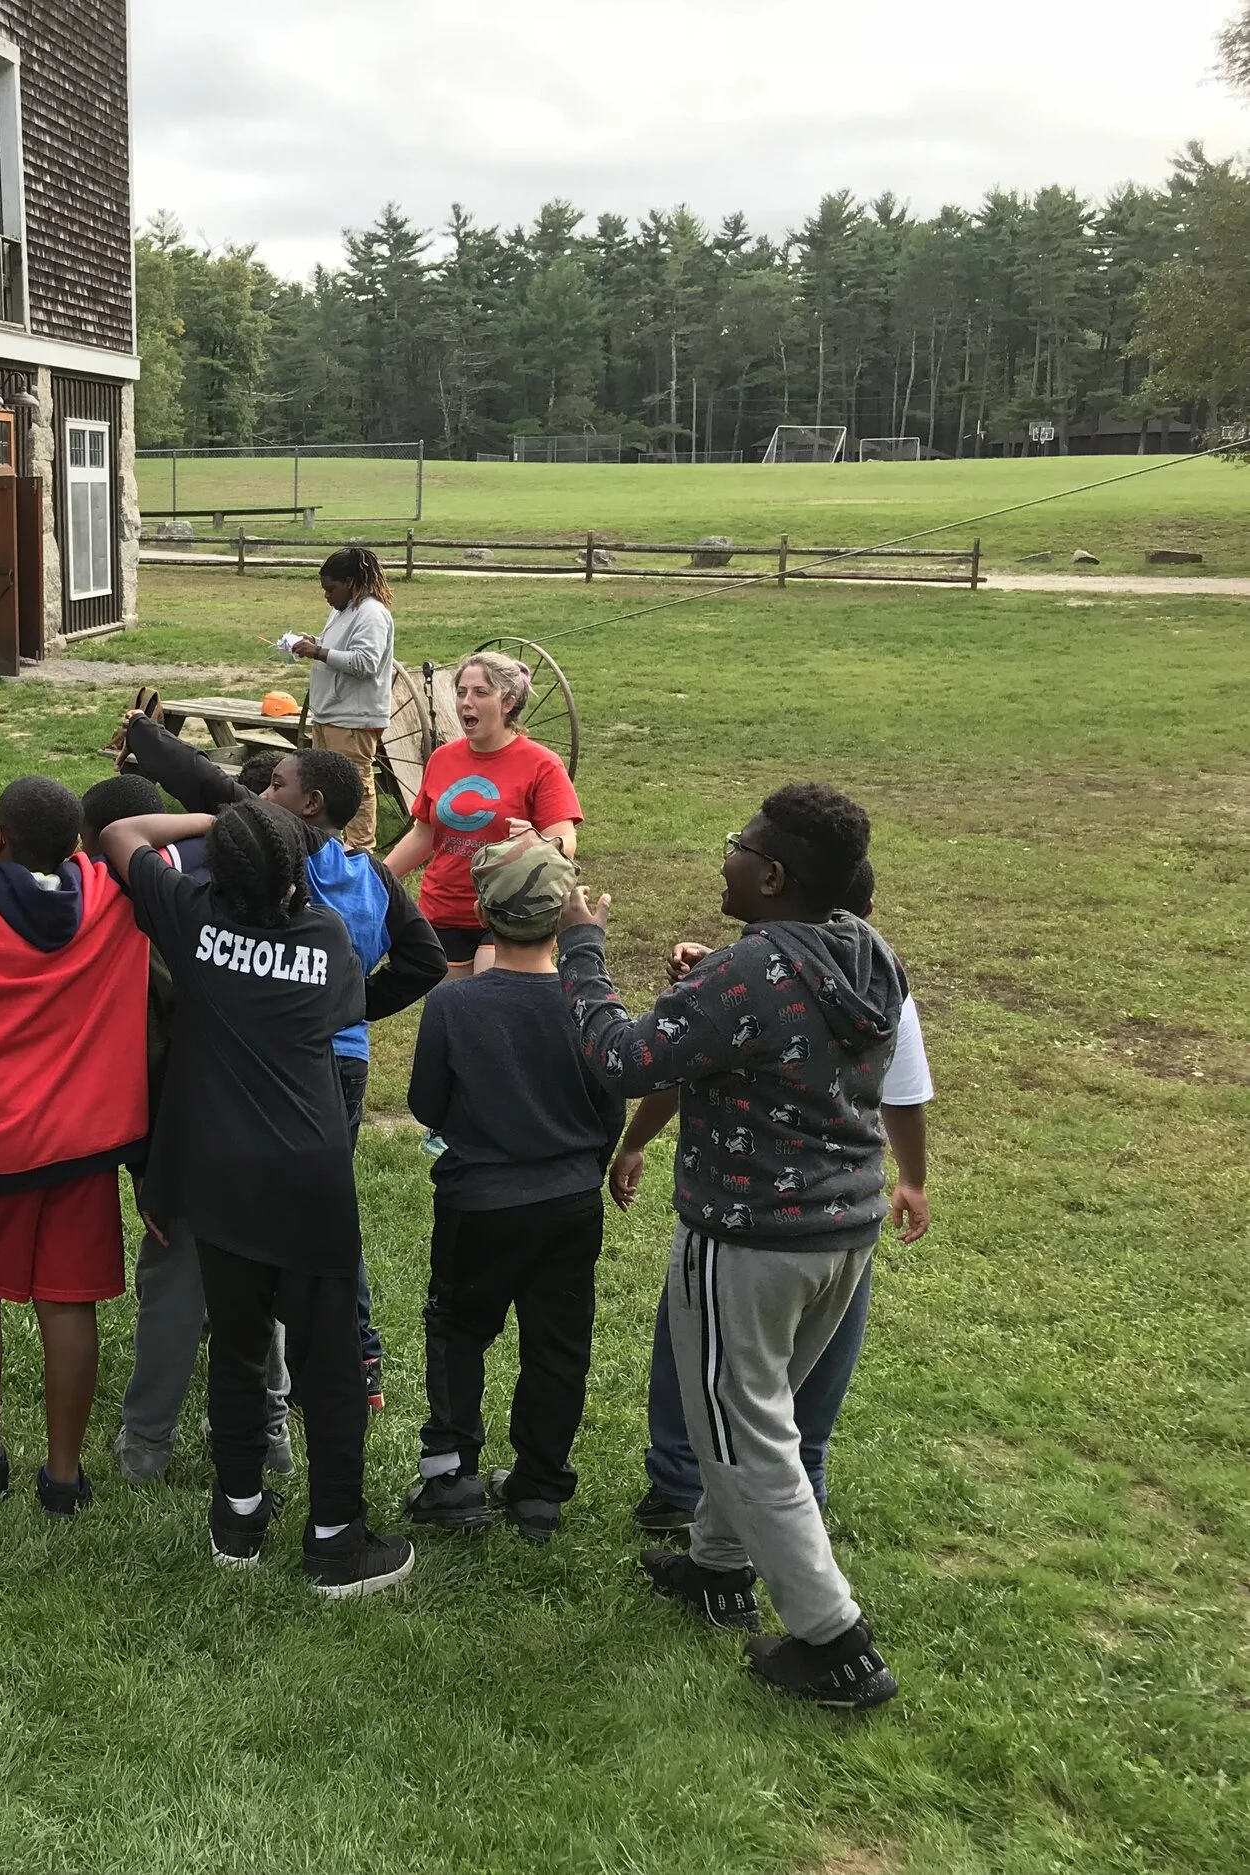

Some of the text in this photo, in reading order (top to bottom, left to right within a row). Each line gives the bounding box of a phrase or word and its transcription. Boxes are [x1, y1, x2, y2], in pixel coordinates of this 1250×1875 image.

[195, 924, 328, 986] SCHOLAR
[720, 982, 748, 1002] DARK
[777, 1002, 806, 1016] DARK
[722, 1174, 750, 1186] DARK
[773, 1205, 803, 1217] DARK
